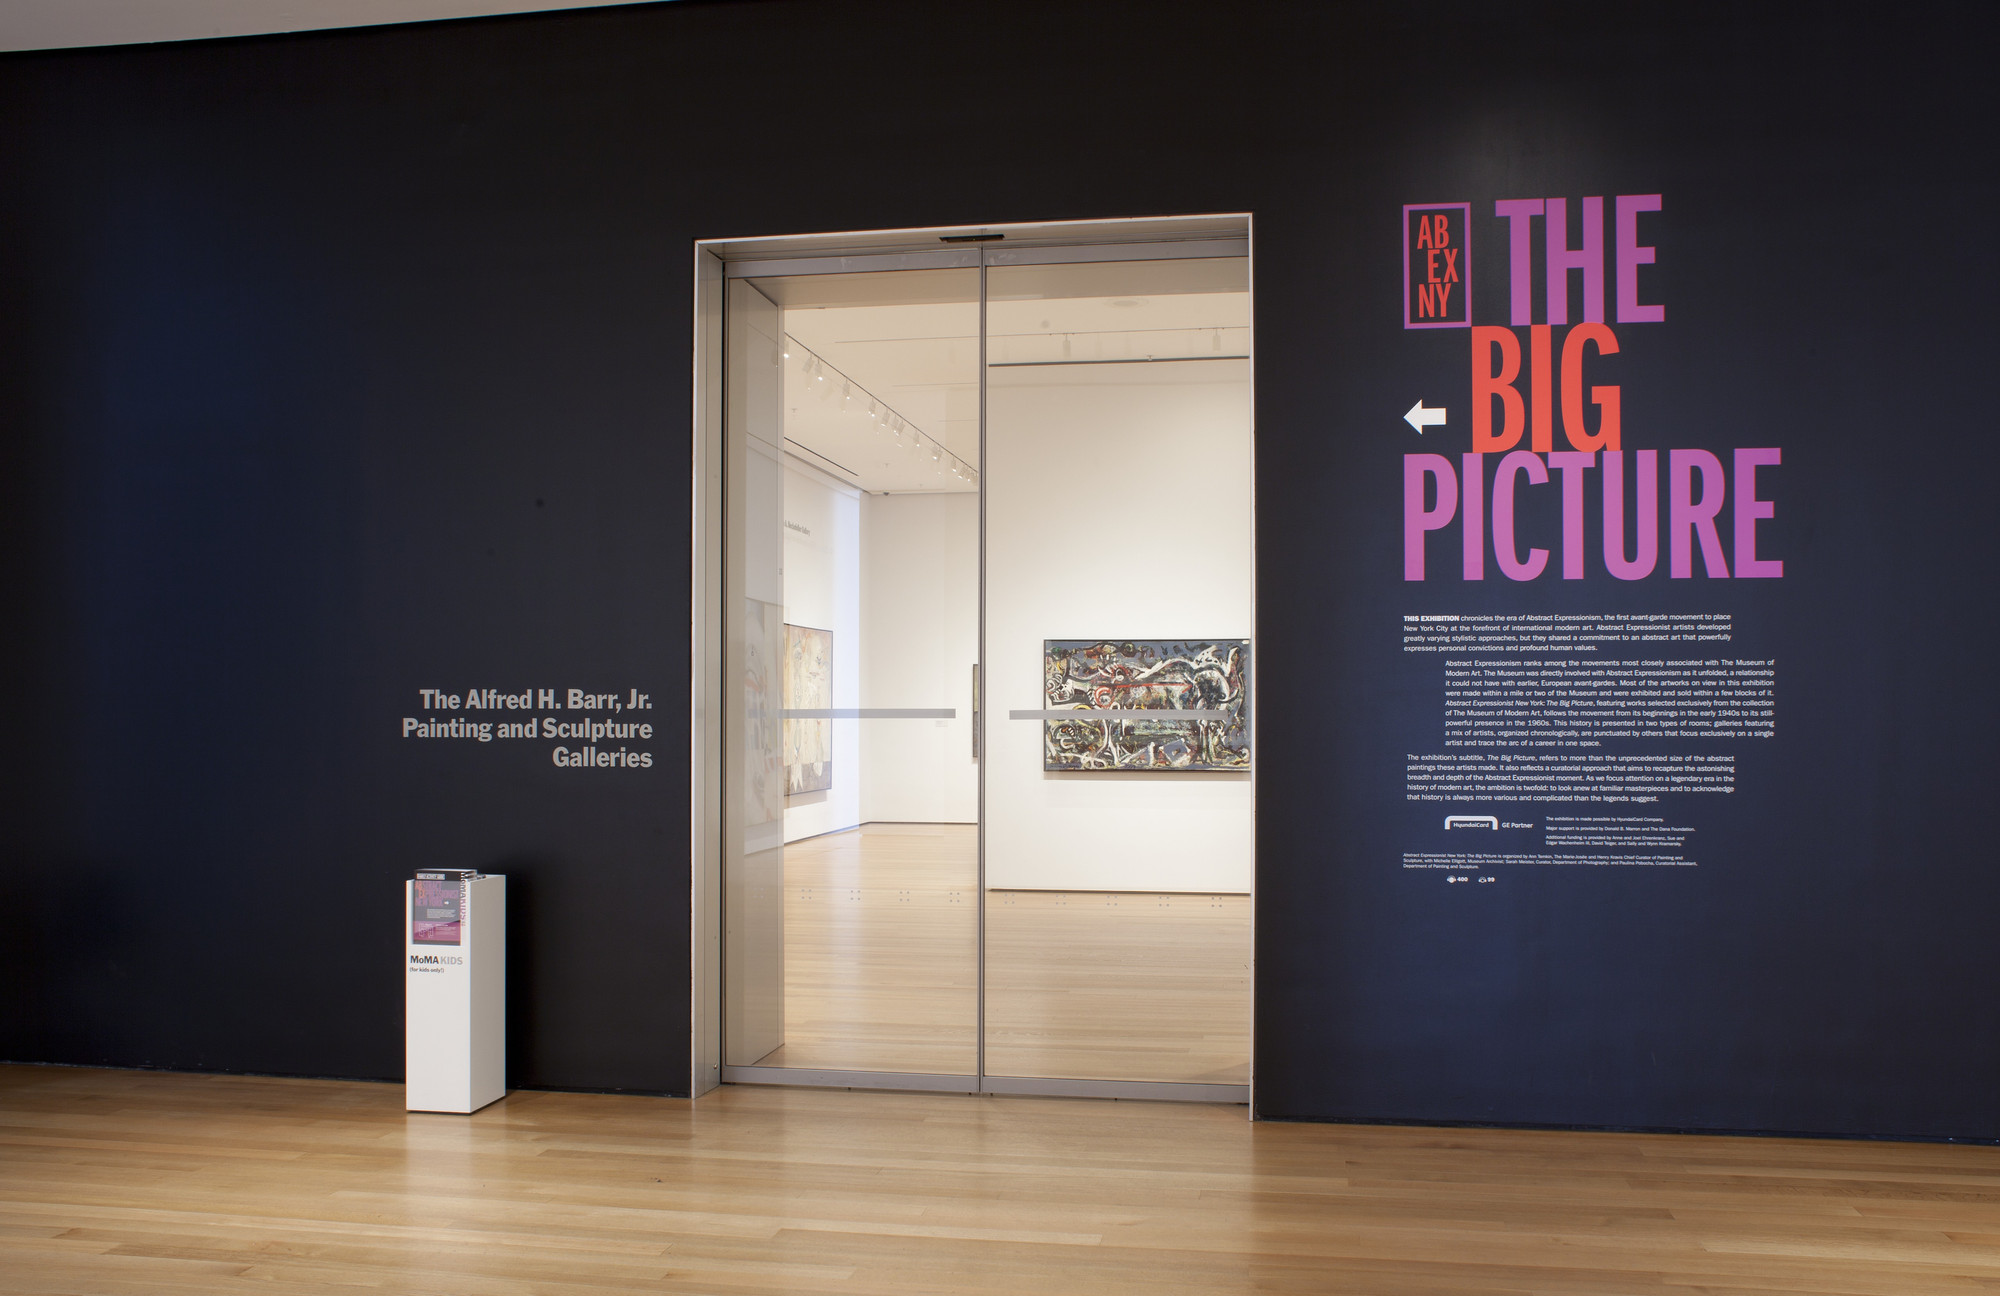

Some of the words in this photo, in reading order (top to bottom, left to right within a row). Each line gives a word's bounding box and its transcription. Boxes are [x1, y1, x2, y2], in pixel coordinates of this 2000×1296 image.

[1417, 214, 1450, 250] AB
[1427, 248, 1459, 283] EX
[1495, 194, 1665, 326] THE
[1418, 282, 1452, 318] NY
[1471, 322, 1621, 453] BIG
[1404, 447, 1784, 581] PICTURE
[1630, 614, 1668, 622] avant-garde
[1626, 624, 1671, 632] Expressionist
[1697, 624, 1732, 632] developed
[1403, 635, 1426, 643] greatly
[1427, 635, 1451, 643] varying
[1698, 634, 1731, 642] powerfully
[1438, 645, 1467, 653] personal
[1519, 645, 1549, 653] profound
[1641, 660, 1665, 668] closely
[419, 688, 461, 710] The
[465, 688, 532, 710] Alfred
[538, 688, 561, 710] H.
[567, 688, 622, 713] Barr,
[627, 688, 652, 710] Jr.
[1530, 710, 1543, 718] Art,
[402, 717, 493, 742] Painting
[497, 717, 537, 738] and
[542, 717, 653, 742] Sculpture
[552, 746, 653, 768] Galleries
[1407, 764, 1436, 772] paintings
[1652, 765, 1684, 773] recapture
[1452, 794, 1475, 802] always
[410, 955, 439, 964] MoMA
[440, 956, 463, 965] KIDS
